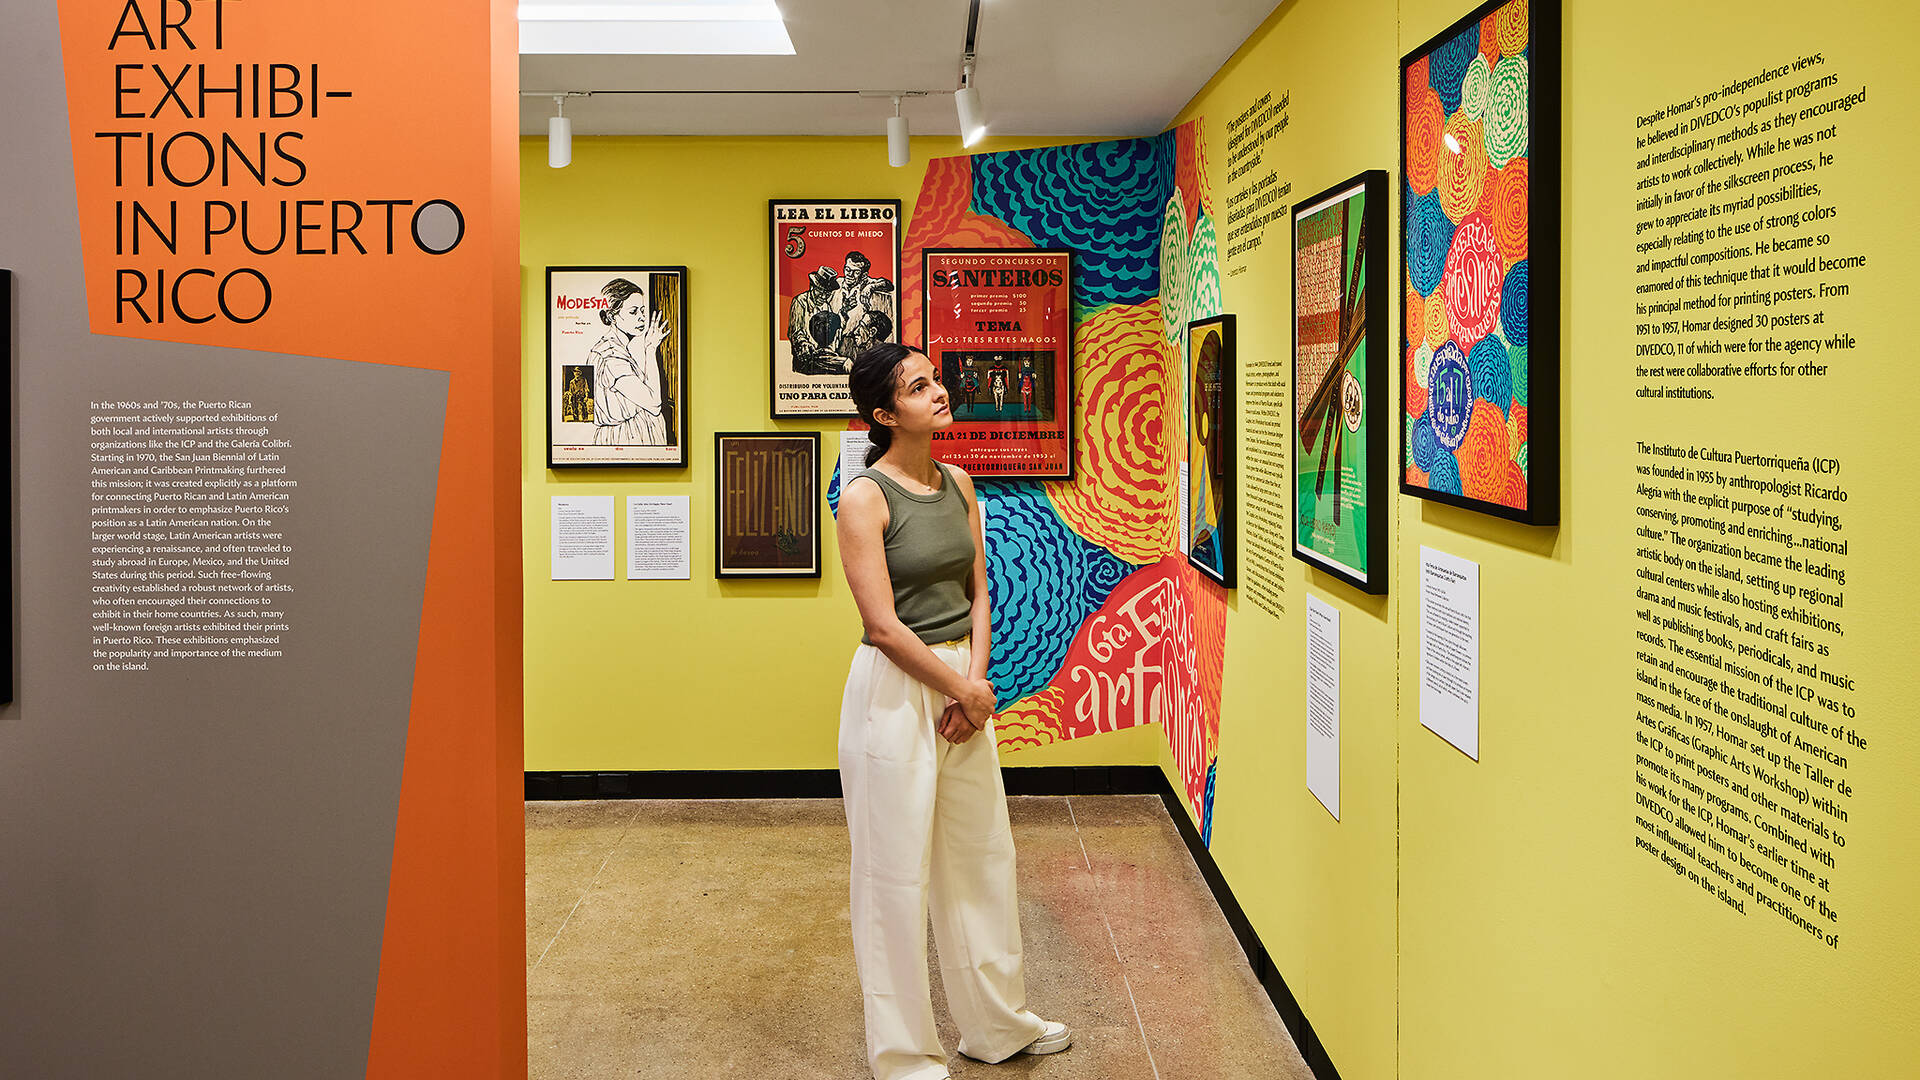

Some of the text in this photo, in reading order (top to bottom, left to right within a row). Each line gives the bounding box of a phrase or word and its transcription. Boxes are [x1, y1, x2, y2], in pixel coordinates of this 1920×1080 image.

[108, 0, 232, 50] ART
[115, 64, 353, 118] EXHIBI-
[1636, 52, 1825, 129] Despite Homar's pro-independence views,
[1636, 73, 1838, 150] he believed in DIVEDCO's populist programs
[95, 132, 307, 188] TIONS
[116, 199, 466, 256] IN PUERTO
[777, 208, 894, 220] LEA EL LIBRO
[785, 226, 806, 259] 5
[932, 269, 1063, 287] SANTEROS
[116, 268, 272, 325] RICO
[557, 295, 609, 310] MODESTA
[975, 321, 1022, 332] TEMA
[1635, 310, 1825, 336] 1951 to 1957, Homar designed 30 posters at
[1436, 368, 1448, 405] 15
[1635, 385, 1715, 400] cultural institutions.
[90, 400, 252, 410] In the 1960s and '70s, the Puerto Rican
[90, 413, 278, 425] government actively supported exhibitions of
[932, 431, 1065, 440] DIA 21 DE DICIEMBRE
[1029, 463, 1042, 471] SAN
[1045, 463, 1063, 471] JUAN
[1636, 440, 1840, 476] The Instituto de Cultura Puertorriqueña (ICP)
[93, 635, 280, 646] in Puerto Rico. These exhibitions emphasized
[1088, 615, 1132, 663] 6ta
[106, 661, 121, 671] the
[122, 661, 149, 671] island.
[1635, 710, 1848, 823] Artes Gráficas (Graphic Arts Workshop) within
[1635, 835, 1747, 916] poster design on the island.
